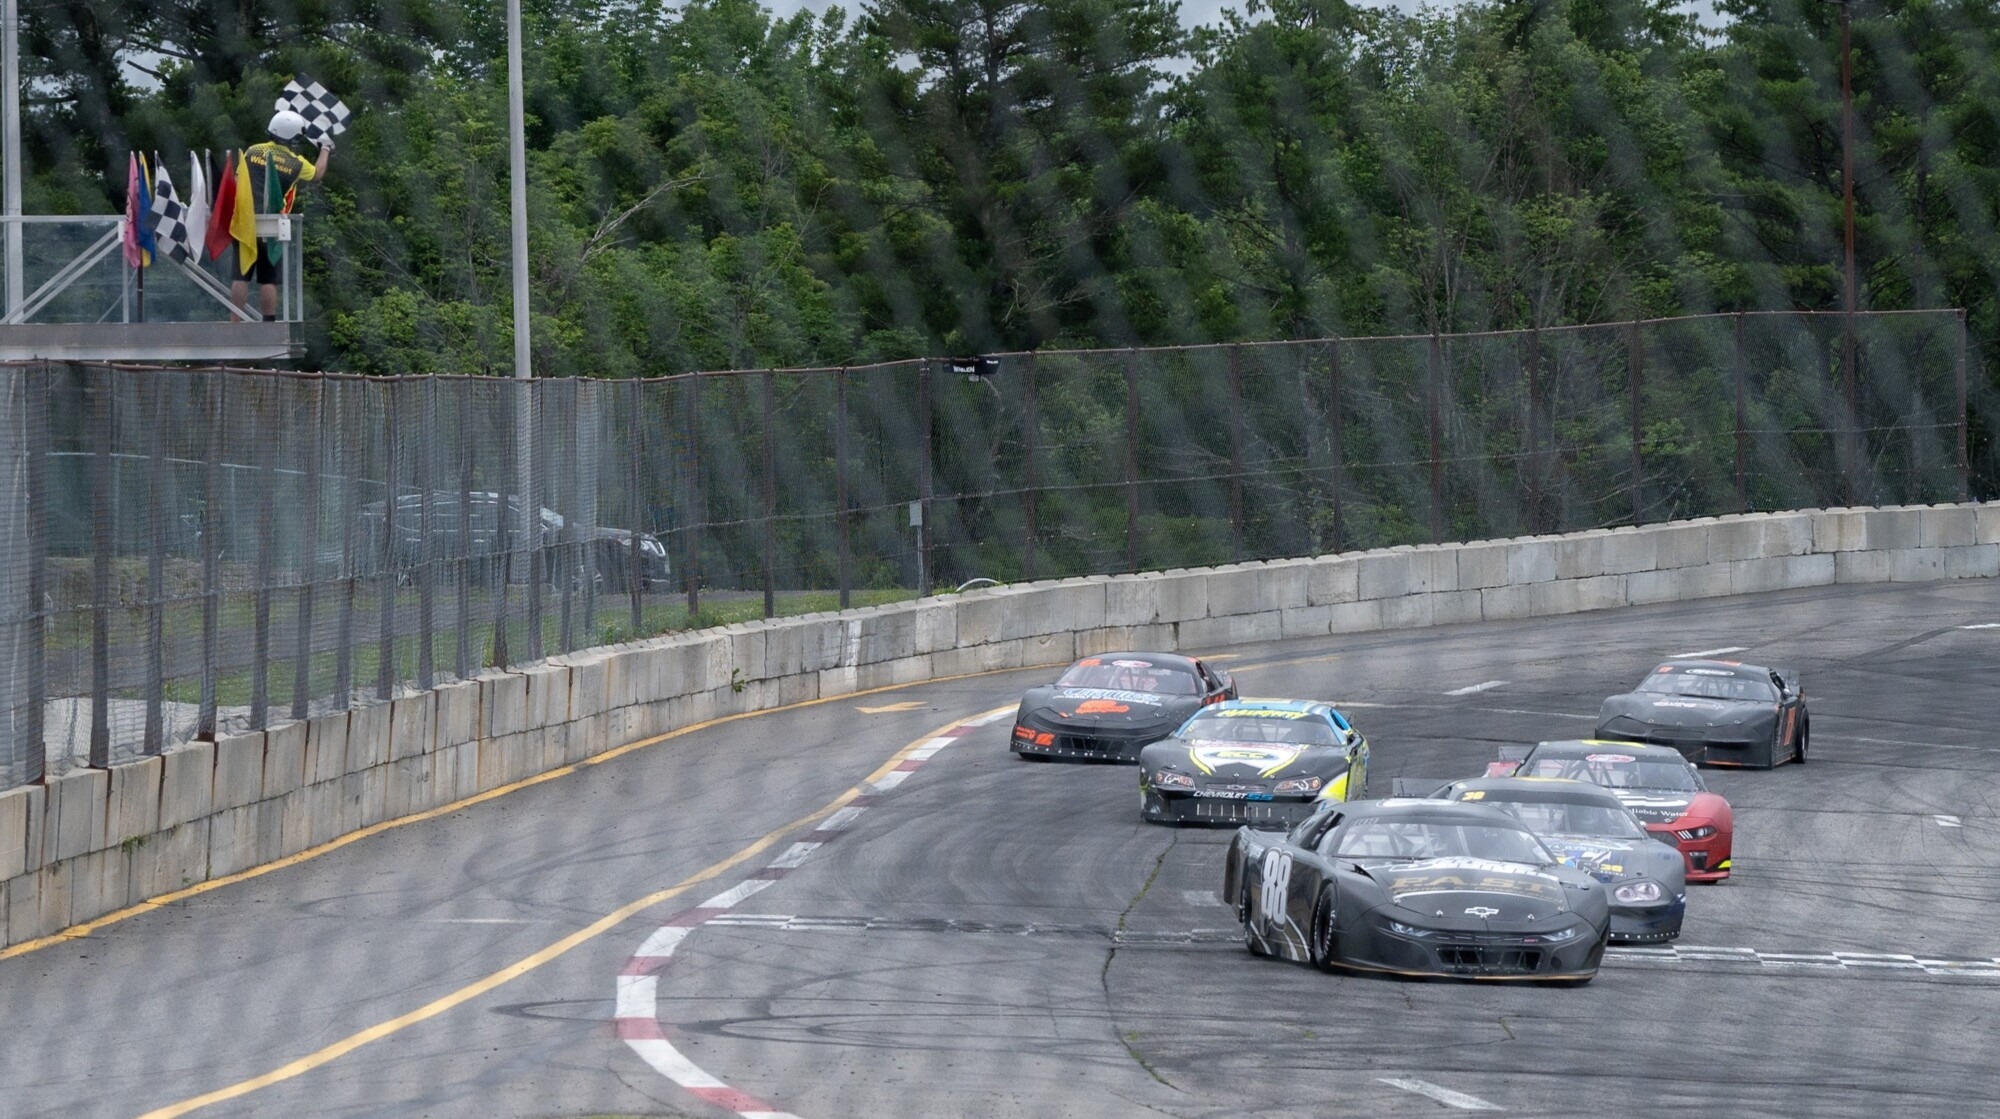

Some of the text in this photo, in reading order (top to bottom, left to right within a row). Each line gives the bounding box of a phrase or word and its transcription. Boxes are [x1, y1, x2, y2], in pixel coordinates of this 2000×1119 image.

[1193, 790, 1274, 801] CHEVROLET SS
[1260, 846, 1294, 931] 88
